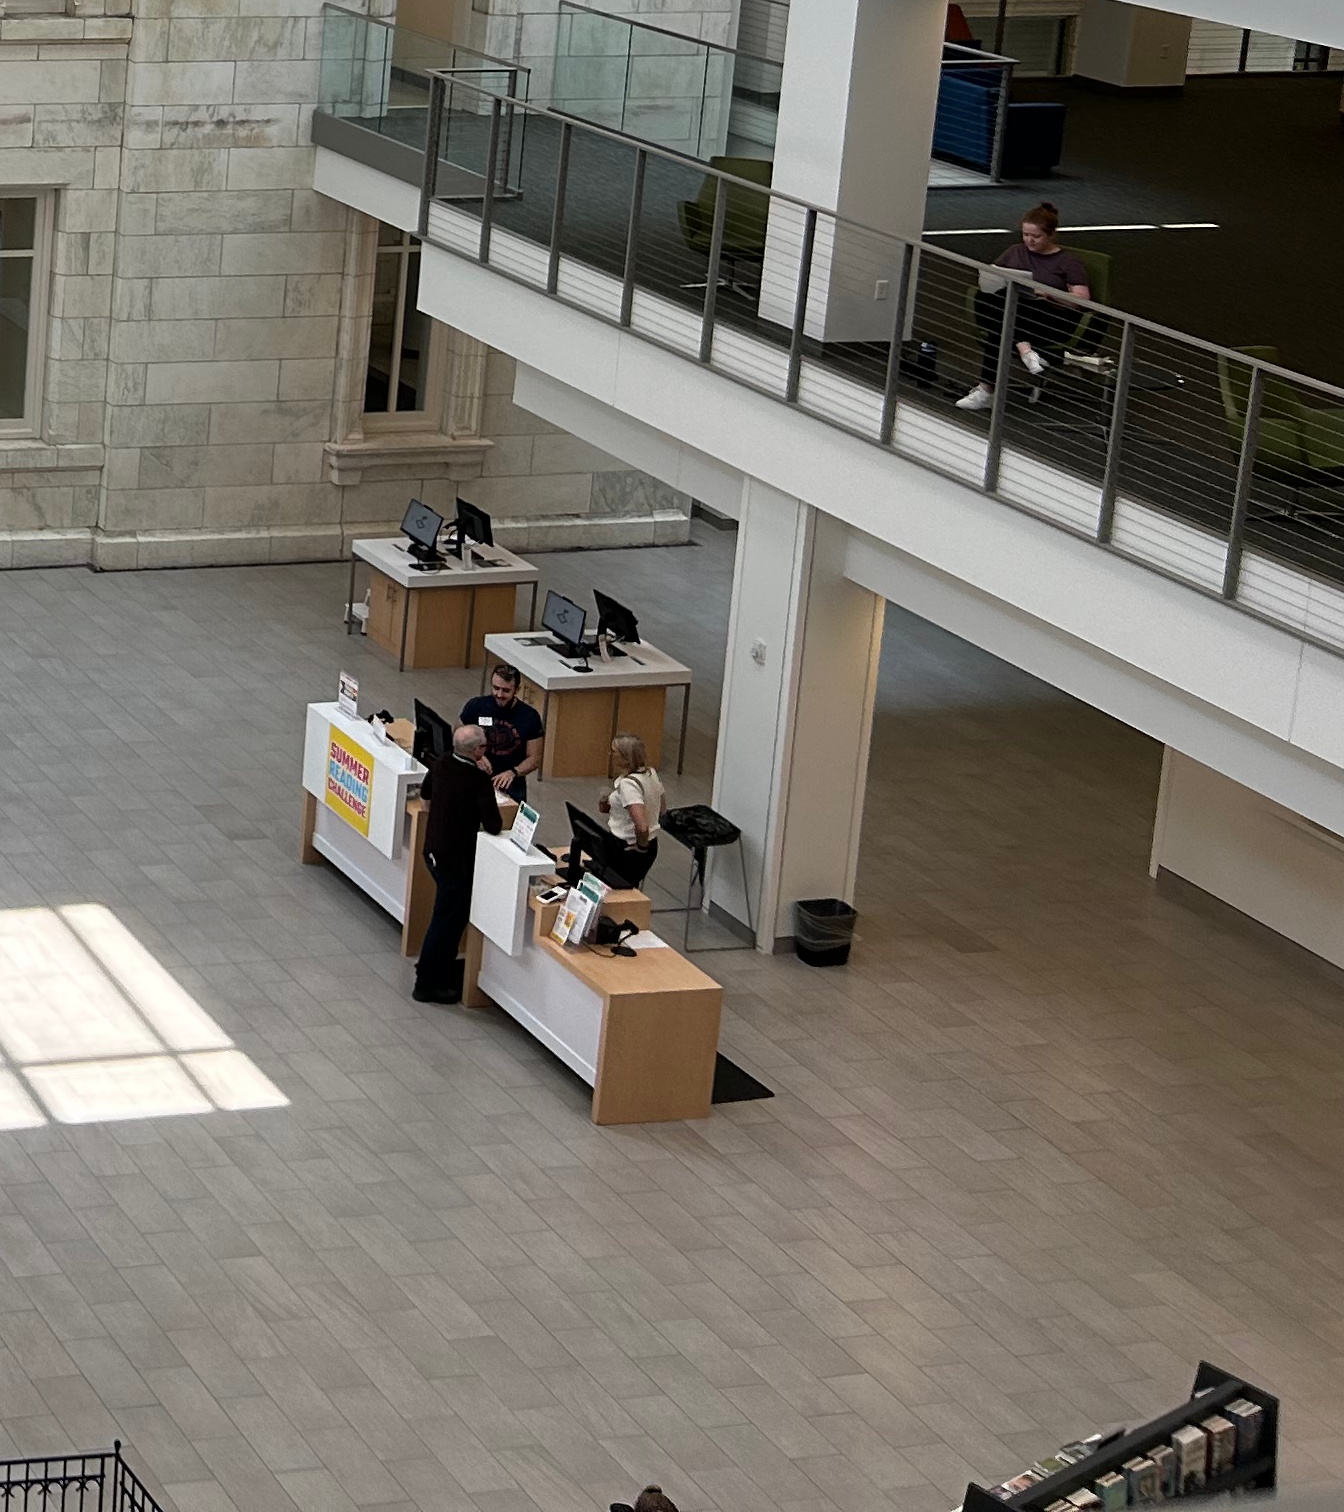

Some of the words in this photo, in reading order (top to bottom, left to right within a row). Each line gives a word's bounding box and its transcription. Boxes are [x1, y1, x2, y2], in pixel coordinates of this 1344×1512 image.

[329, 759, 368, 803] READING
[330, 742, 369, 785] SUMMER
[328, 777, 367, 818] CHALLENGE
